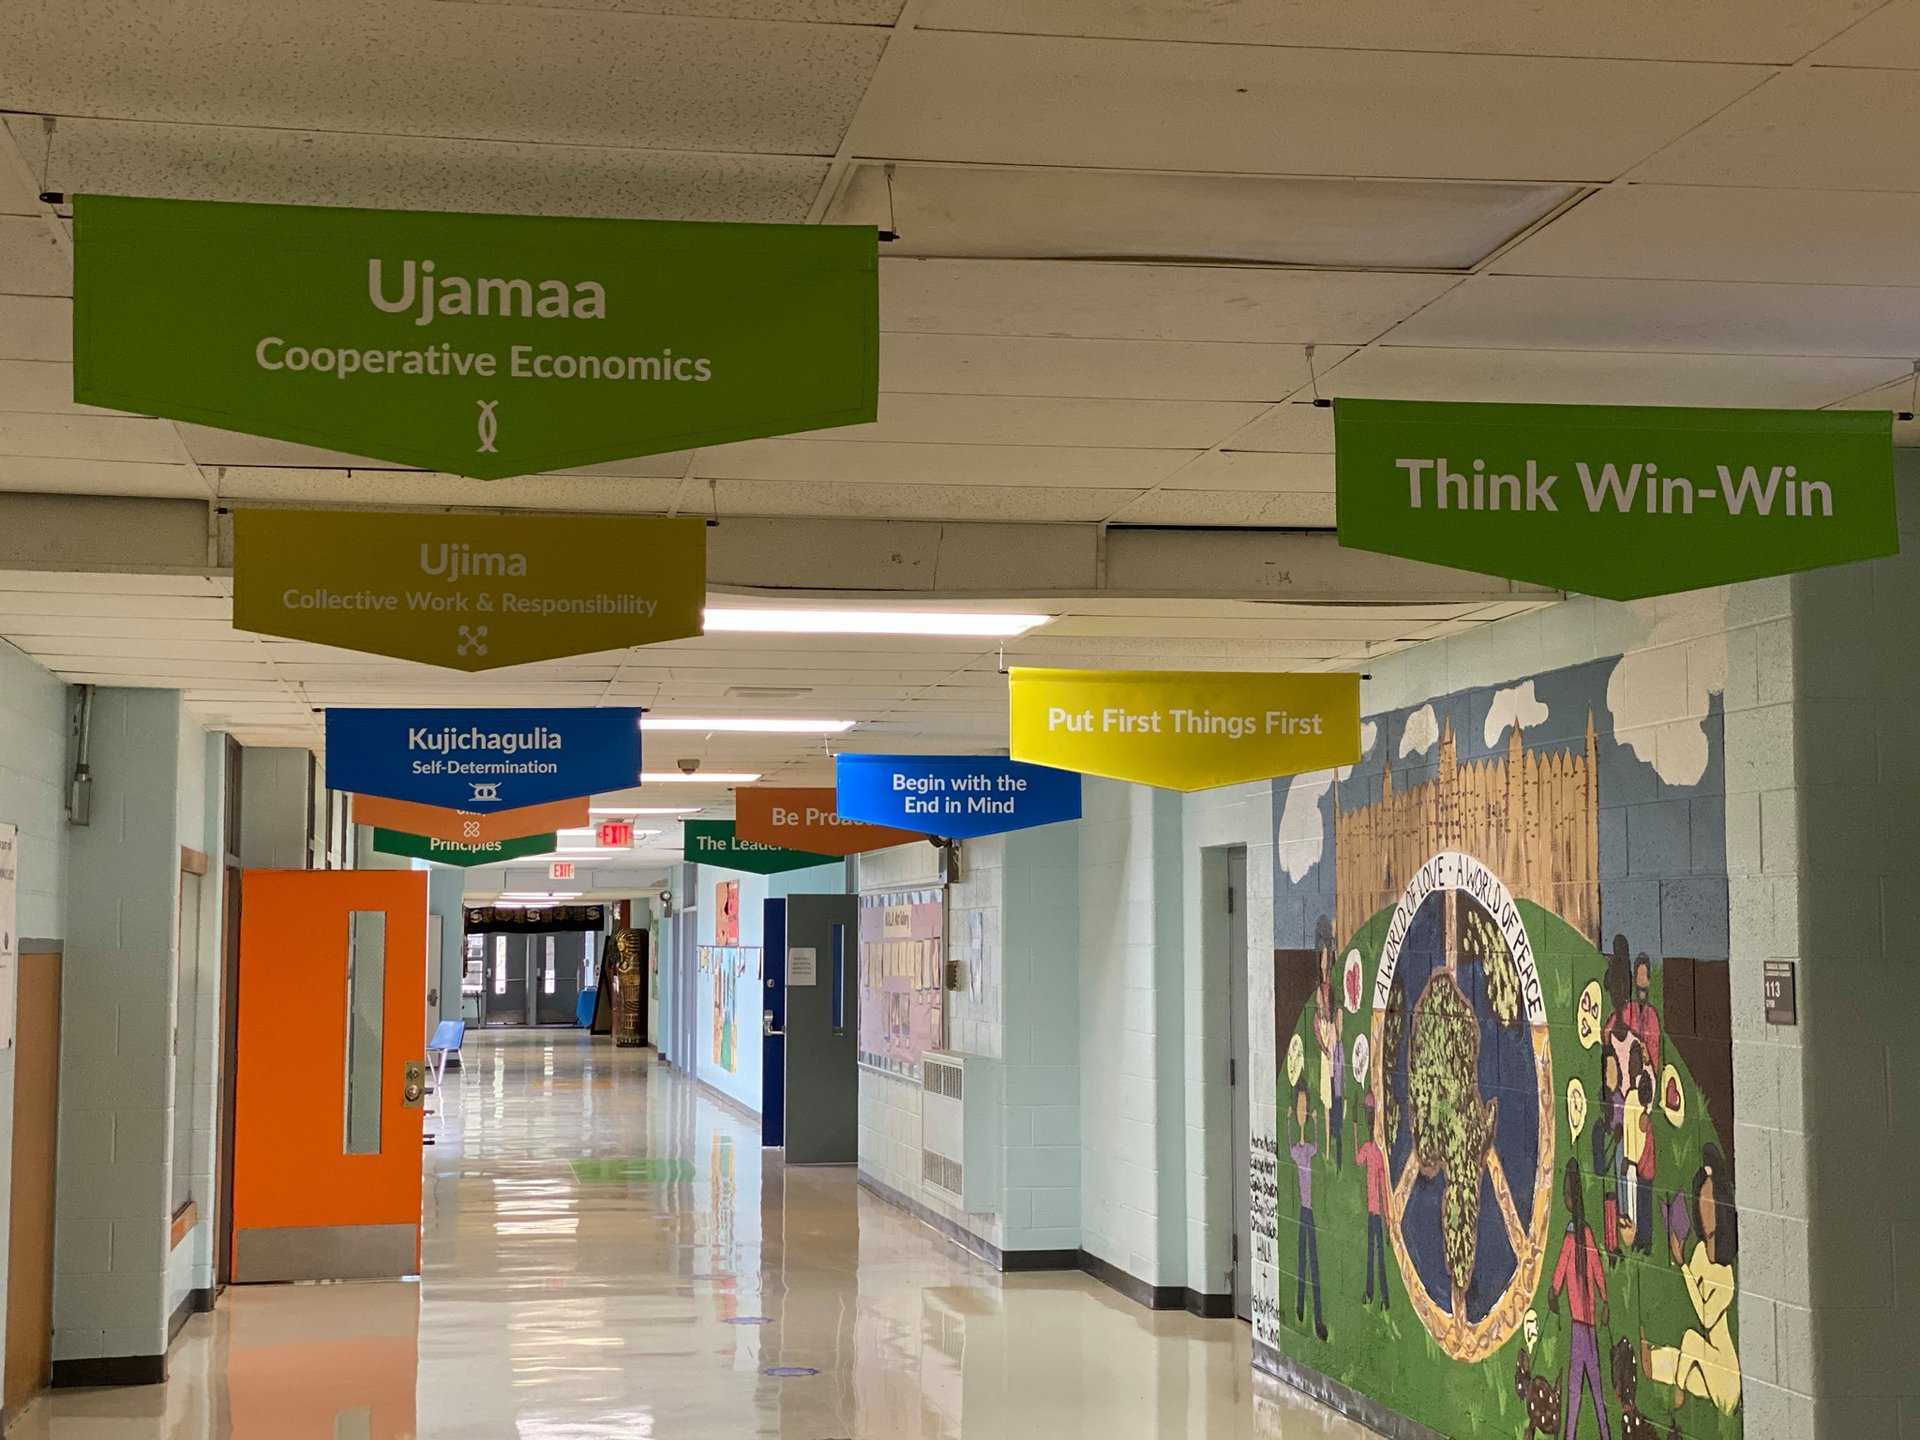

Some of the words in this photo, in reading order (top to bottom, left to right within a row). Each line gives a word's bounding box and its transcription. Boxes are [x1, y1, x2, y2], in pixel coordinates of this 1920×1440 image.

[368, 258, 607, 326] Ujamaa
[255, 336, 497, 380] Cooperative
[510, 344, 712, 382] Economics
[1395, 457, 1559, 512] Think
[1575, 462, 1834, 517] Win-Win
[420, 543, 527, 583] Ujima
[282, 588, 398, 610] Collective
[405, 591, 469, 612] Work
[475, 593, 494, 612] &
[502, 592, 658, 618] Responsibility
[1048, 707, 1094, 733] Put
[1102, 708, 1161, 733] First
[1169, 709, 1256, 739] Things
[1265, 711, 1323, 736] First
[408, 727, 562, 755] Kujichagulia
[412, 760, 558, 775] Self-Determination
[893, 773, 945, 794] Begin
[951, 774, 991, 791] with
[997, 775, 1027, 791] the
[772, 807, 799, 826] Be
[904, 796, 939, 813] End
[945, 797, 961, 813] in
[968, 797, 1015, 814] Mind
[602, 824, 628, 845] EXIT
[696, 836, 717, 850] The
[554, 864, 572, 878] EXIT
[1381, 907, 1406, 980] WORLD
[1405, 882, 1417, 916] OF
[1417, 856, 1445, 898] LOVE
[1456, 855, 1464, 886] A
[1466, 858, 1500, 914] WORLD
[1502, 902, 1519, 934] OF
[1513, 929, 1543, 1019] PEACE
[1765, 981, 1780, 997] 113
